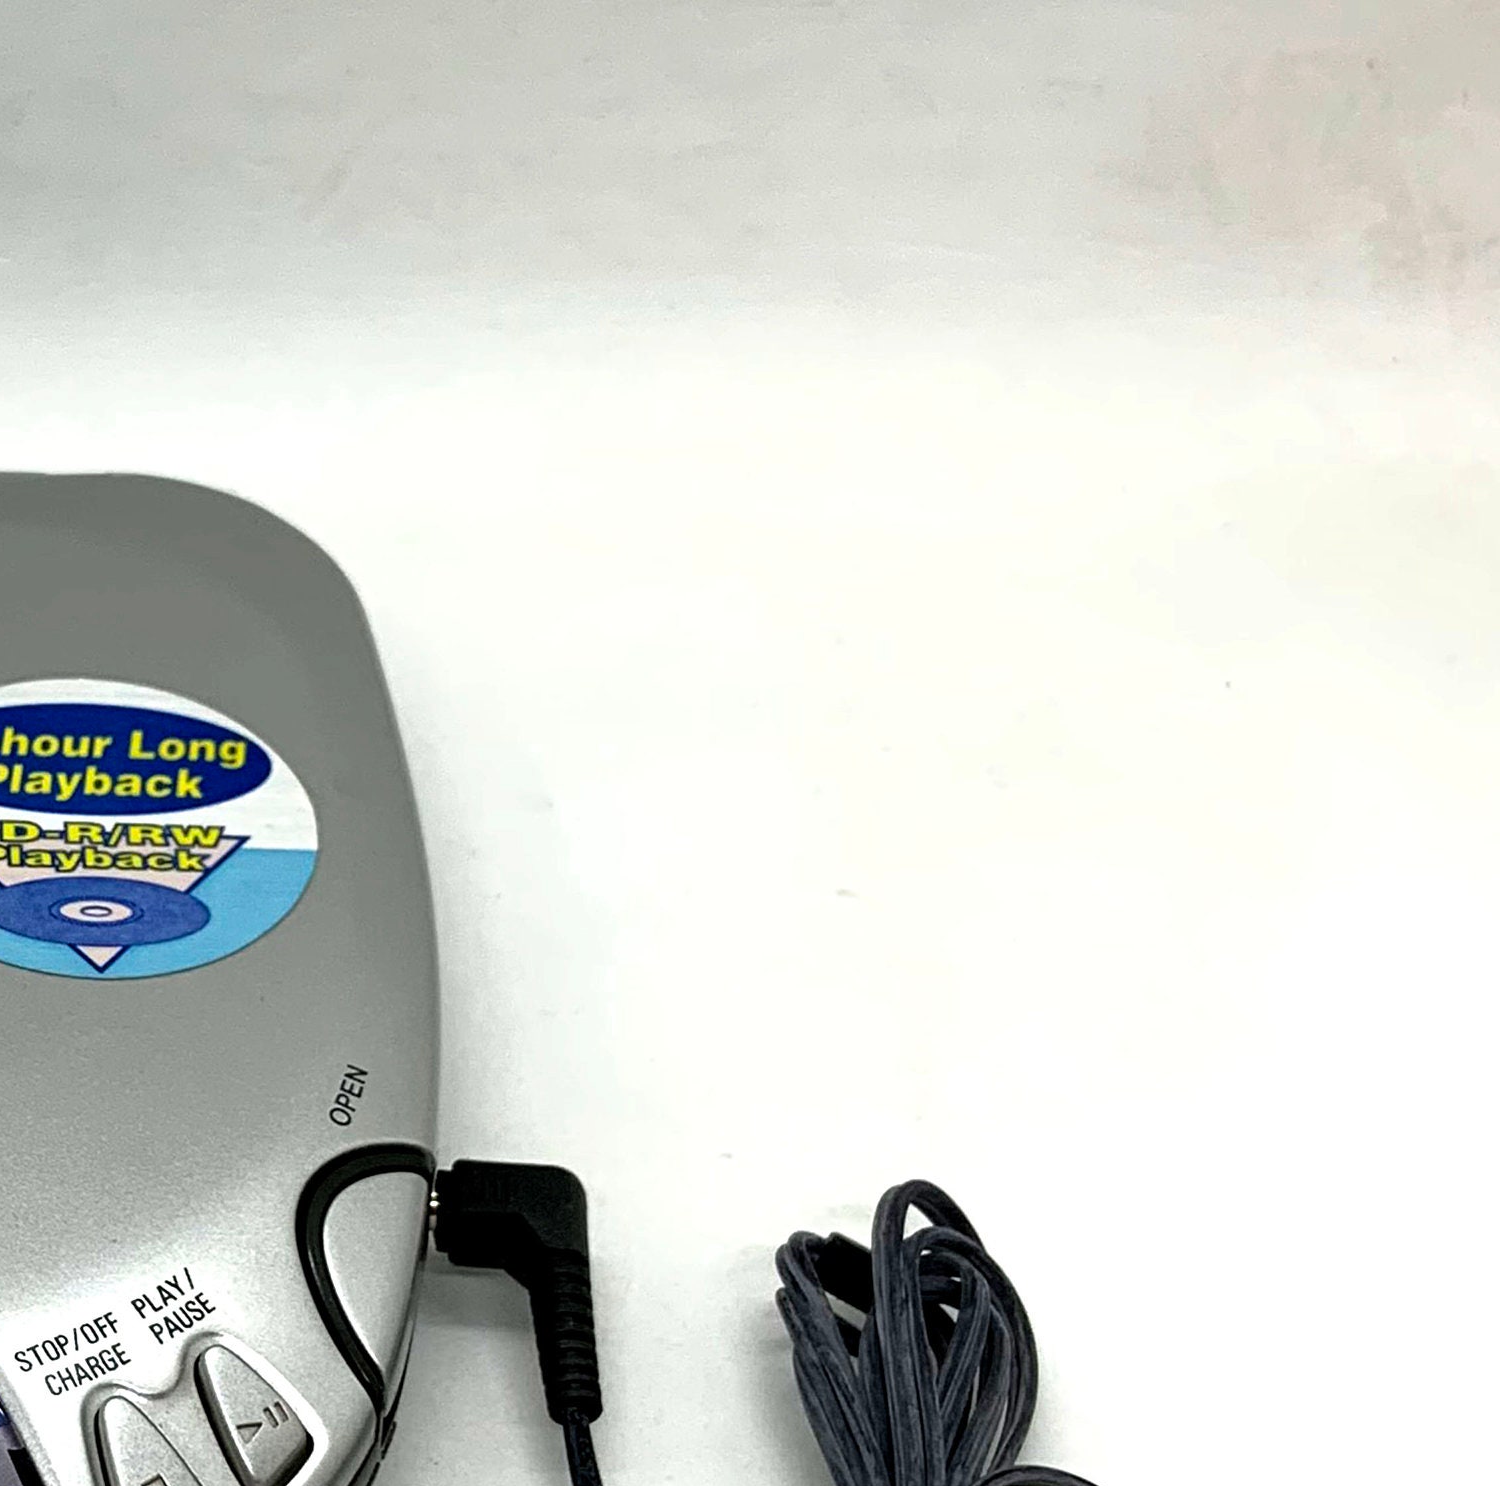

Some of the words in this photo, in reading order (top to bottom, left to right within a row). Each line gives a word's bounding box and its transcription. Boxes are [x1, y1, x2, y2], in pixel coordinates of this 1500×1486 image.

[128, 730, 248, 770] Long
[328, 1064, 369, 1128] OPEN
[131, 1267, 196, 1320] PLAY/
[149, 1292, 217, 1345] PAUSE
[14, 1312, 120, 1373] STOP/OFF
[45, 1343, 132, 1397] CHARGE
